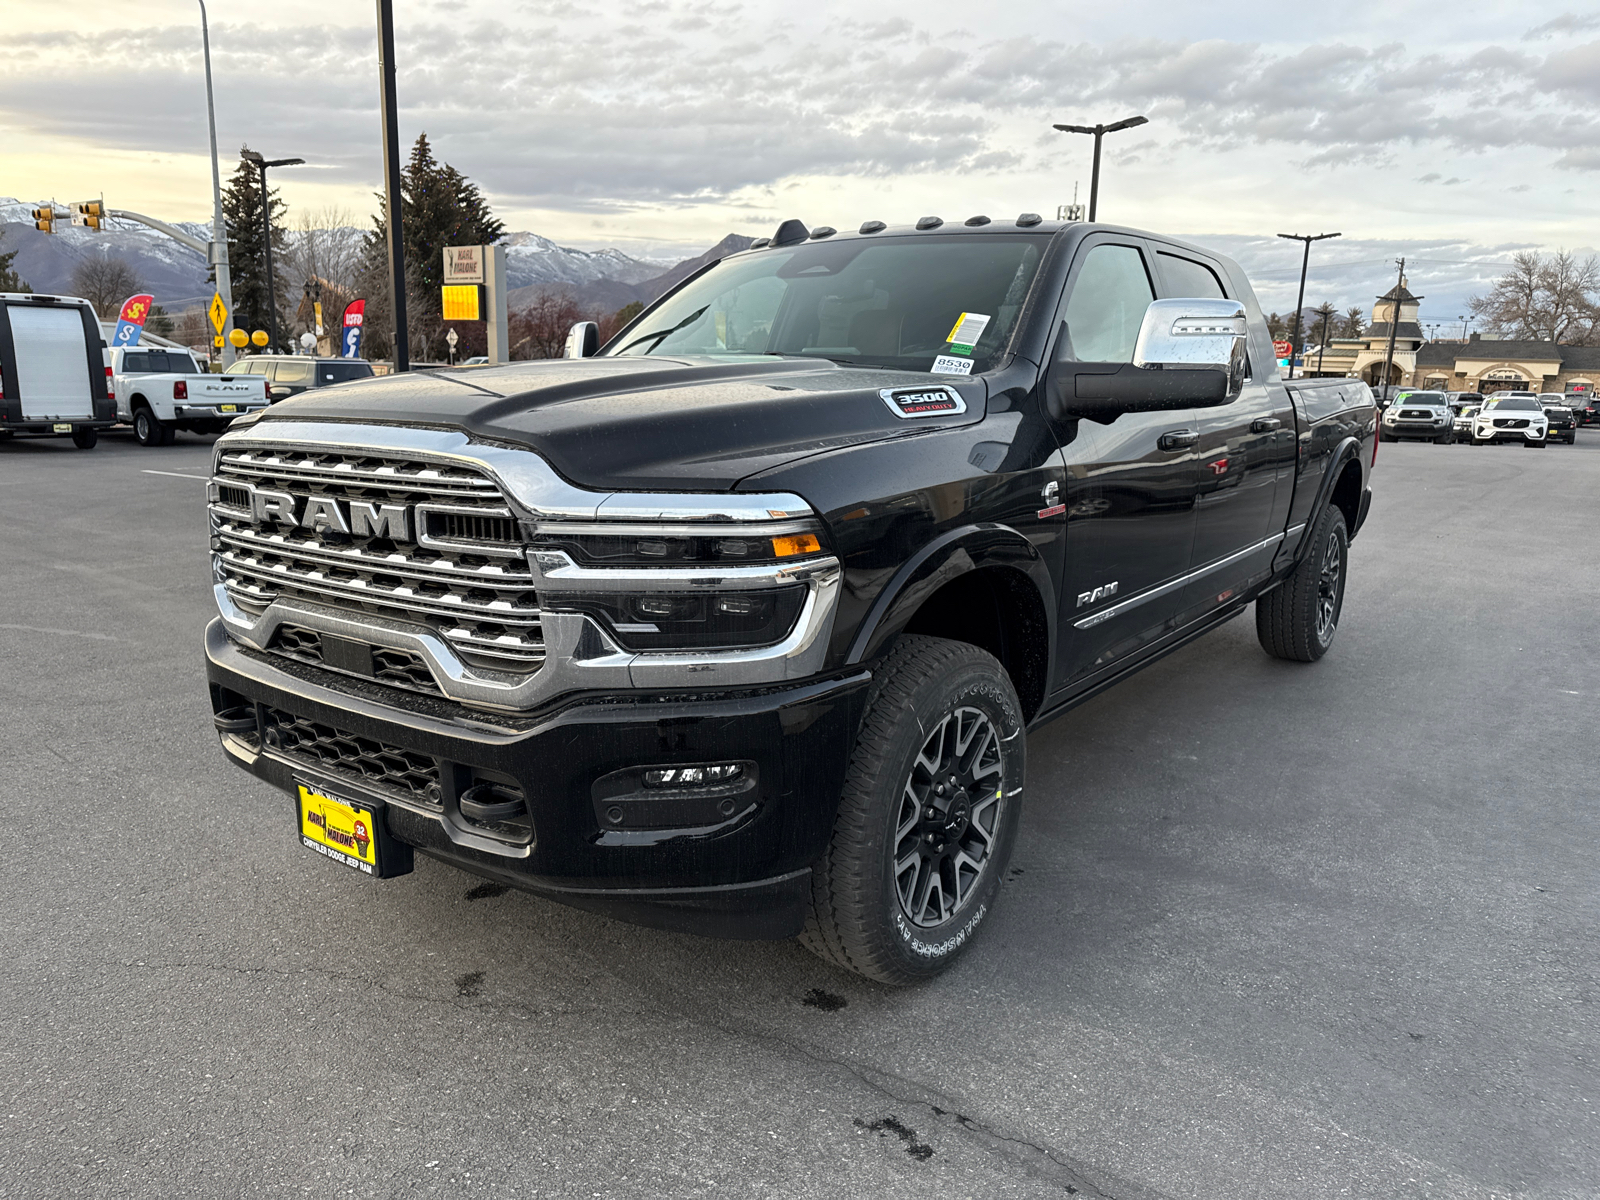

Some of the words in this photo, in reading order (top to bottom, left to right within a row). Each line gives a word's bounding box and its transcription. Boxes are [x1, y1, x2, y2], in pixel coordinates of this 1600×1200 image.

[458, 248, 473, 261] KARL
[454, 261, 478, 275] MALONE
[937, 358, 971, 369] 8530
[897, 392, 948, 405] 3500
[904, 405, 931, 413] HEAVY
[254, 489, 412, 542] RAM
[1076, 581, 1119, 608] RAM
[307, 810, 324, 828] KARL
[326, 827, 355, 849] MALONE
[356, 825, 366, 836] 32
[303, 837, 328, 856] CHRYSLER
[327, 849, 346, 864] DODGE
[346, 857, 359, 869] JEEP
[359, 861, 372, 874] RAM
[911, 904, 987, 958] TRANSFORCE
